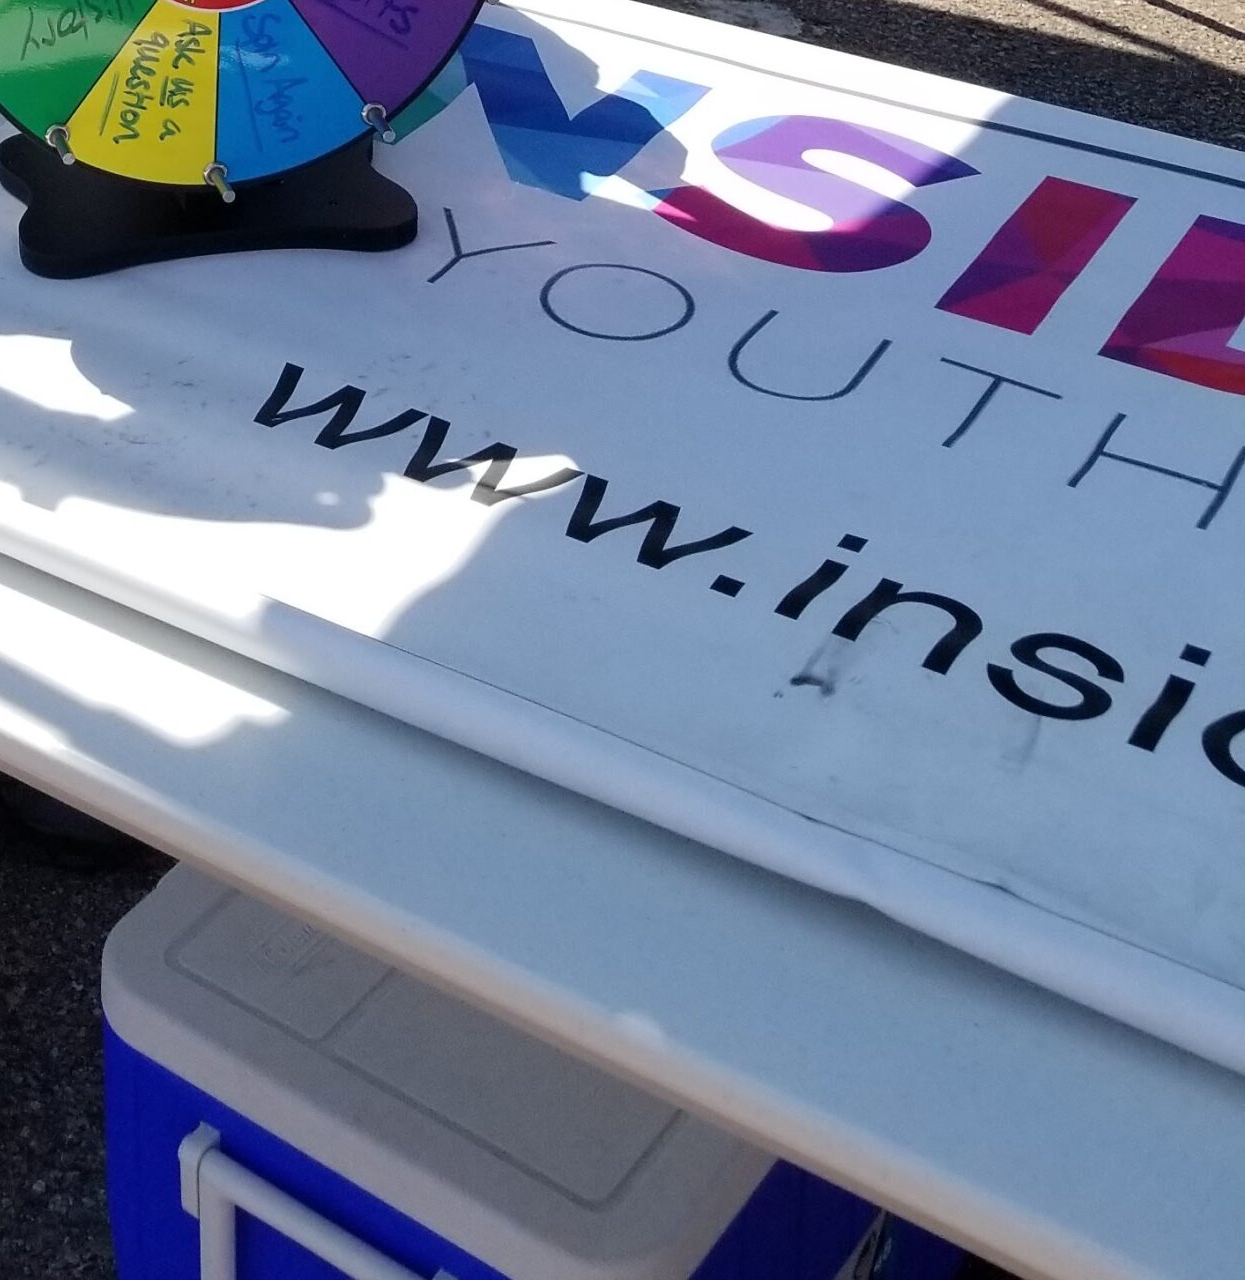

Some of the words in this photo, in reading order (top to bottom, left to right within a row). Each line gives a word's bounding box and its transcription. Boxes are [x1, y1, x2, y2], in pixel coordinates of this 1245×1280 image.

[172, 18, 213, 70] Ask
[112, 31, 171, 145] question
[254, 77, 309, 144] Again
[158, 118, 182, 141] a
[427, 206, 1245, 531] YOUTH
